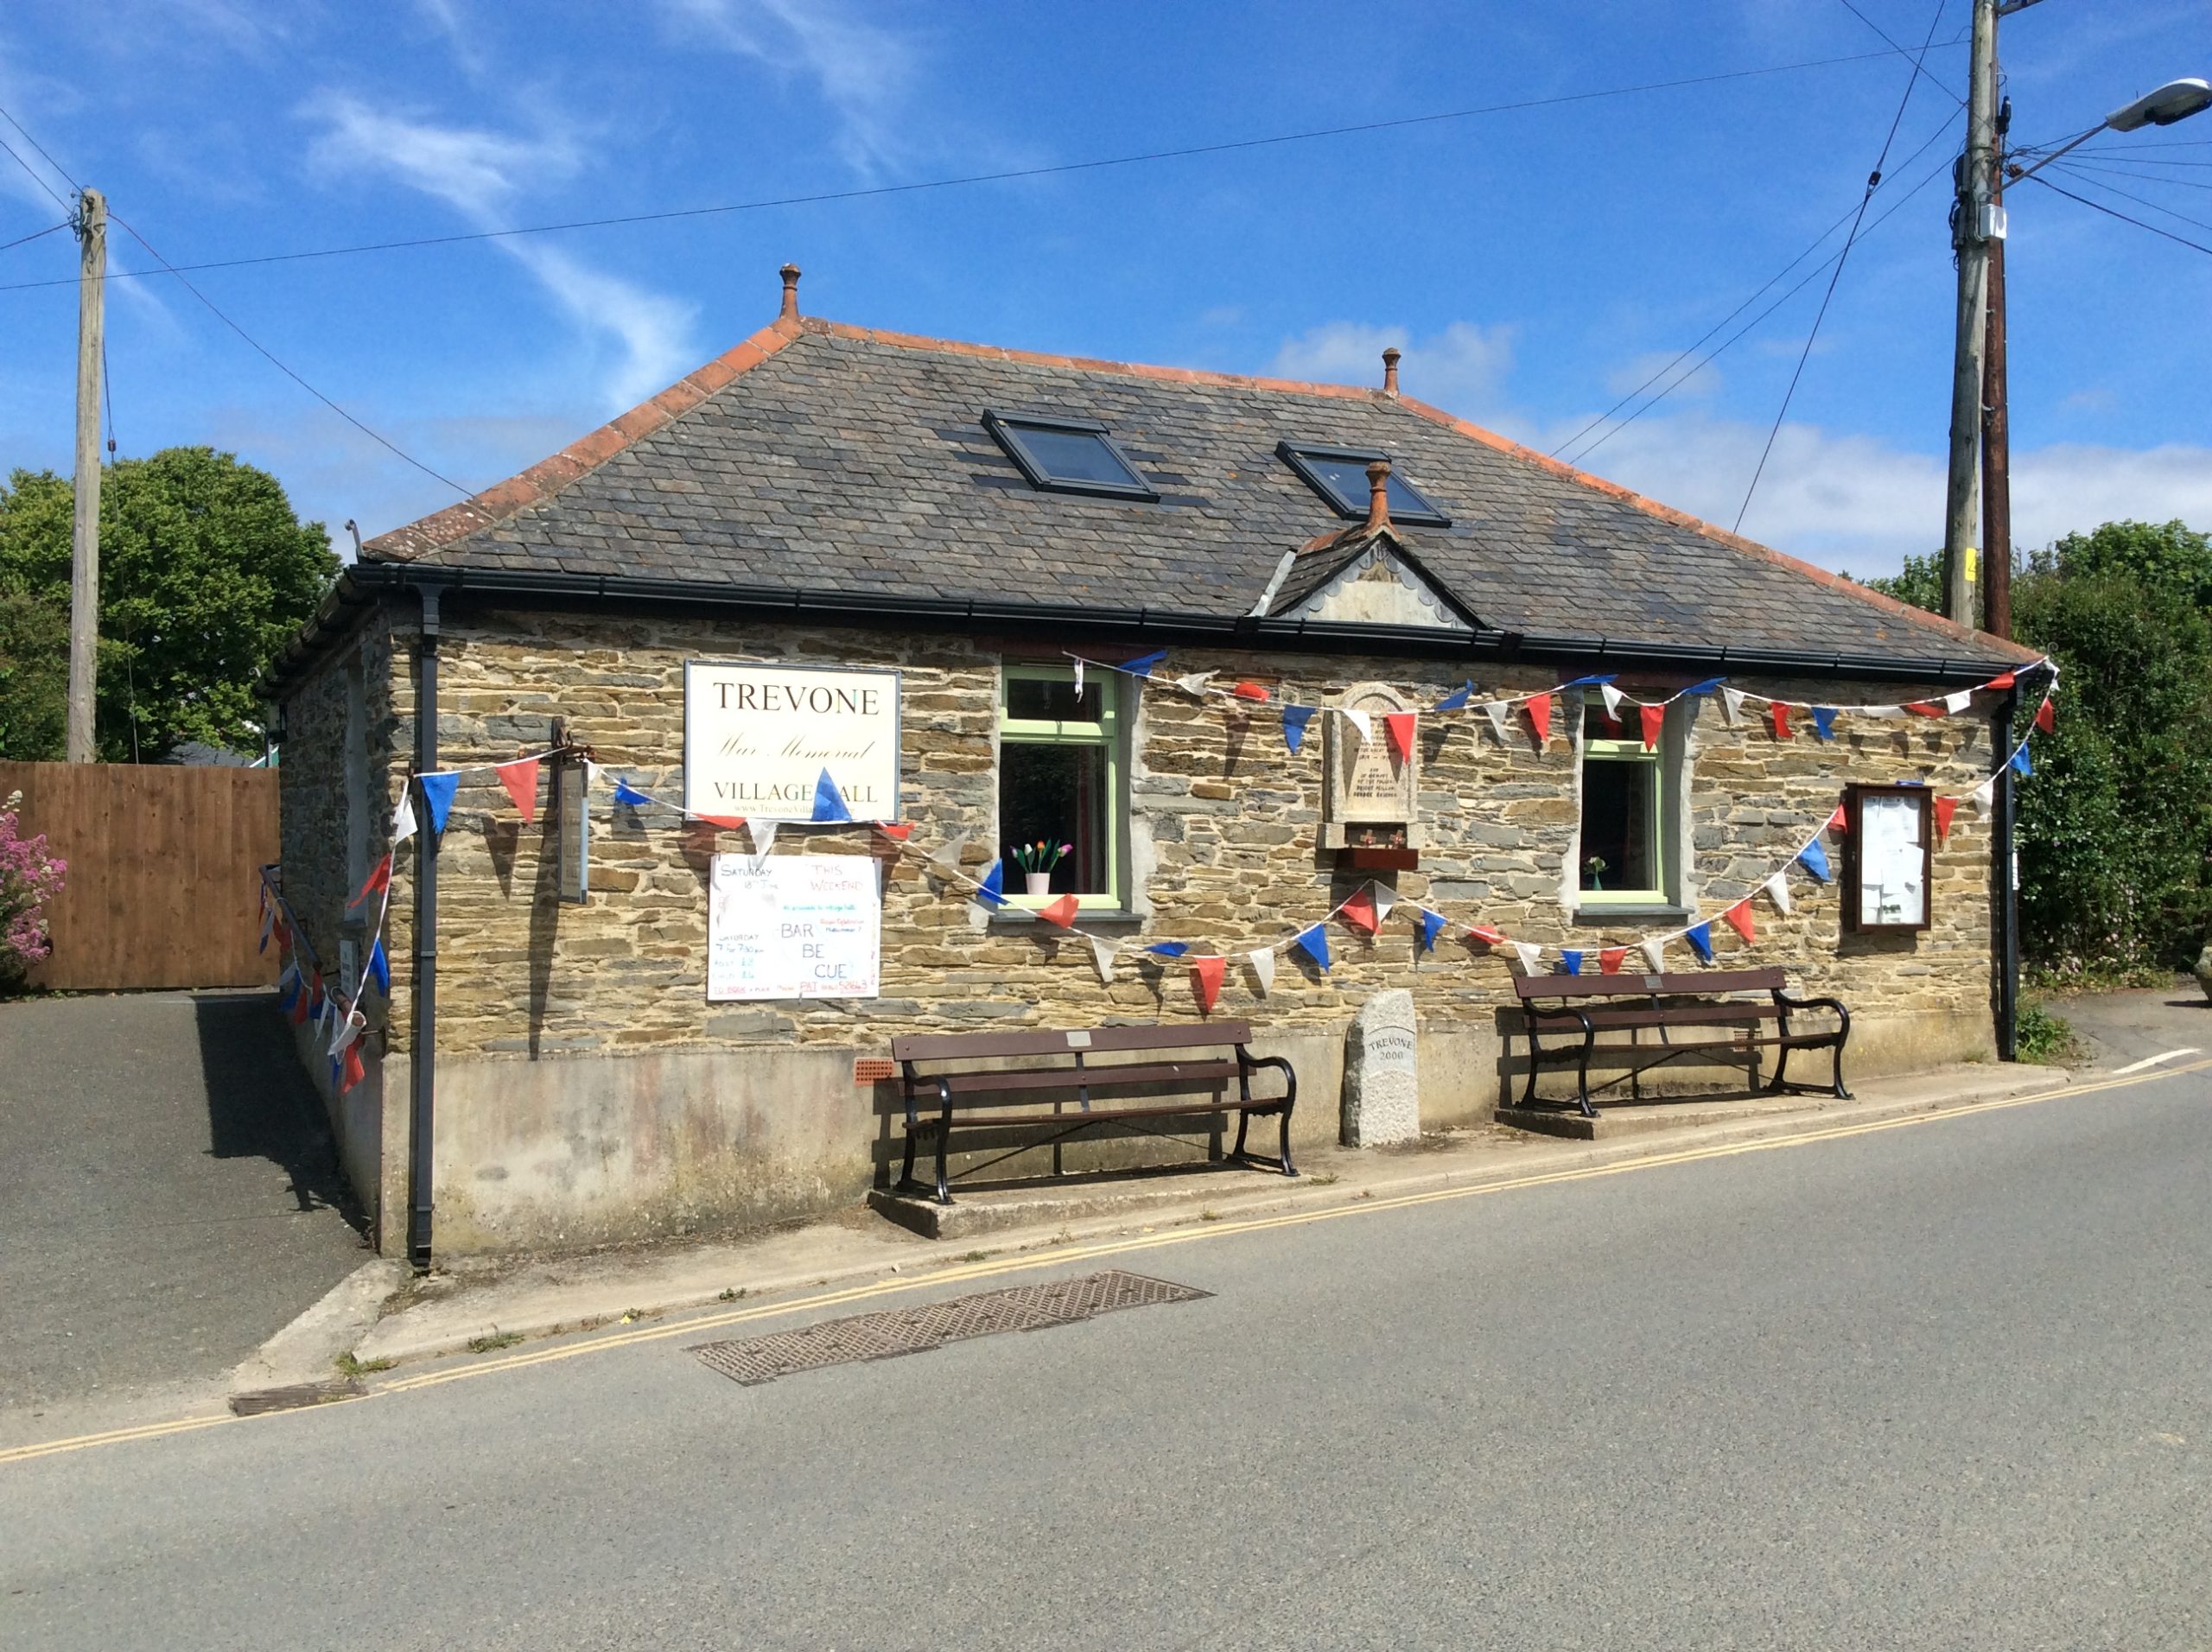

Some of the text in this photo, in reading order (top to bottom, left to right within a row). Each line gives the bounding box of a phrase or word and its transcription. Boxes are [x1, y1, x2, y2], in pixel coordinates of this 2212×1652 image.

[713, 682, 880, 715] TREVONE
[717, 732, 876, 759] War Memorial
[714, 781, 879, 804] VILLAGE ALL
[811, 865, 843, 877] THIS
[810, 880, 863, 892] WEEKEND
[781, 923, 814, 938] BAR
[802, 944, 825, 959] BE
[814, 963, 848, 979] CUE
[1369, 1036, 1414, 1052] TREVONE
[1380, 1051, 1404, 1061] 2000
